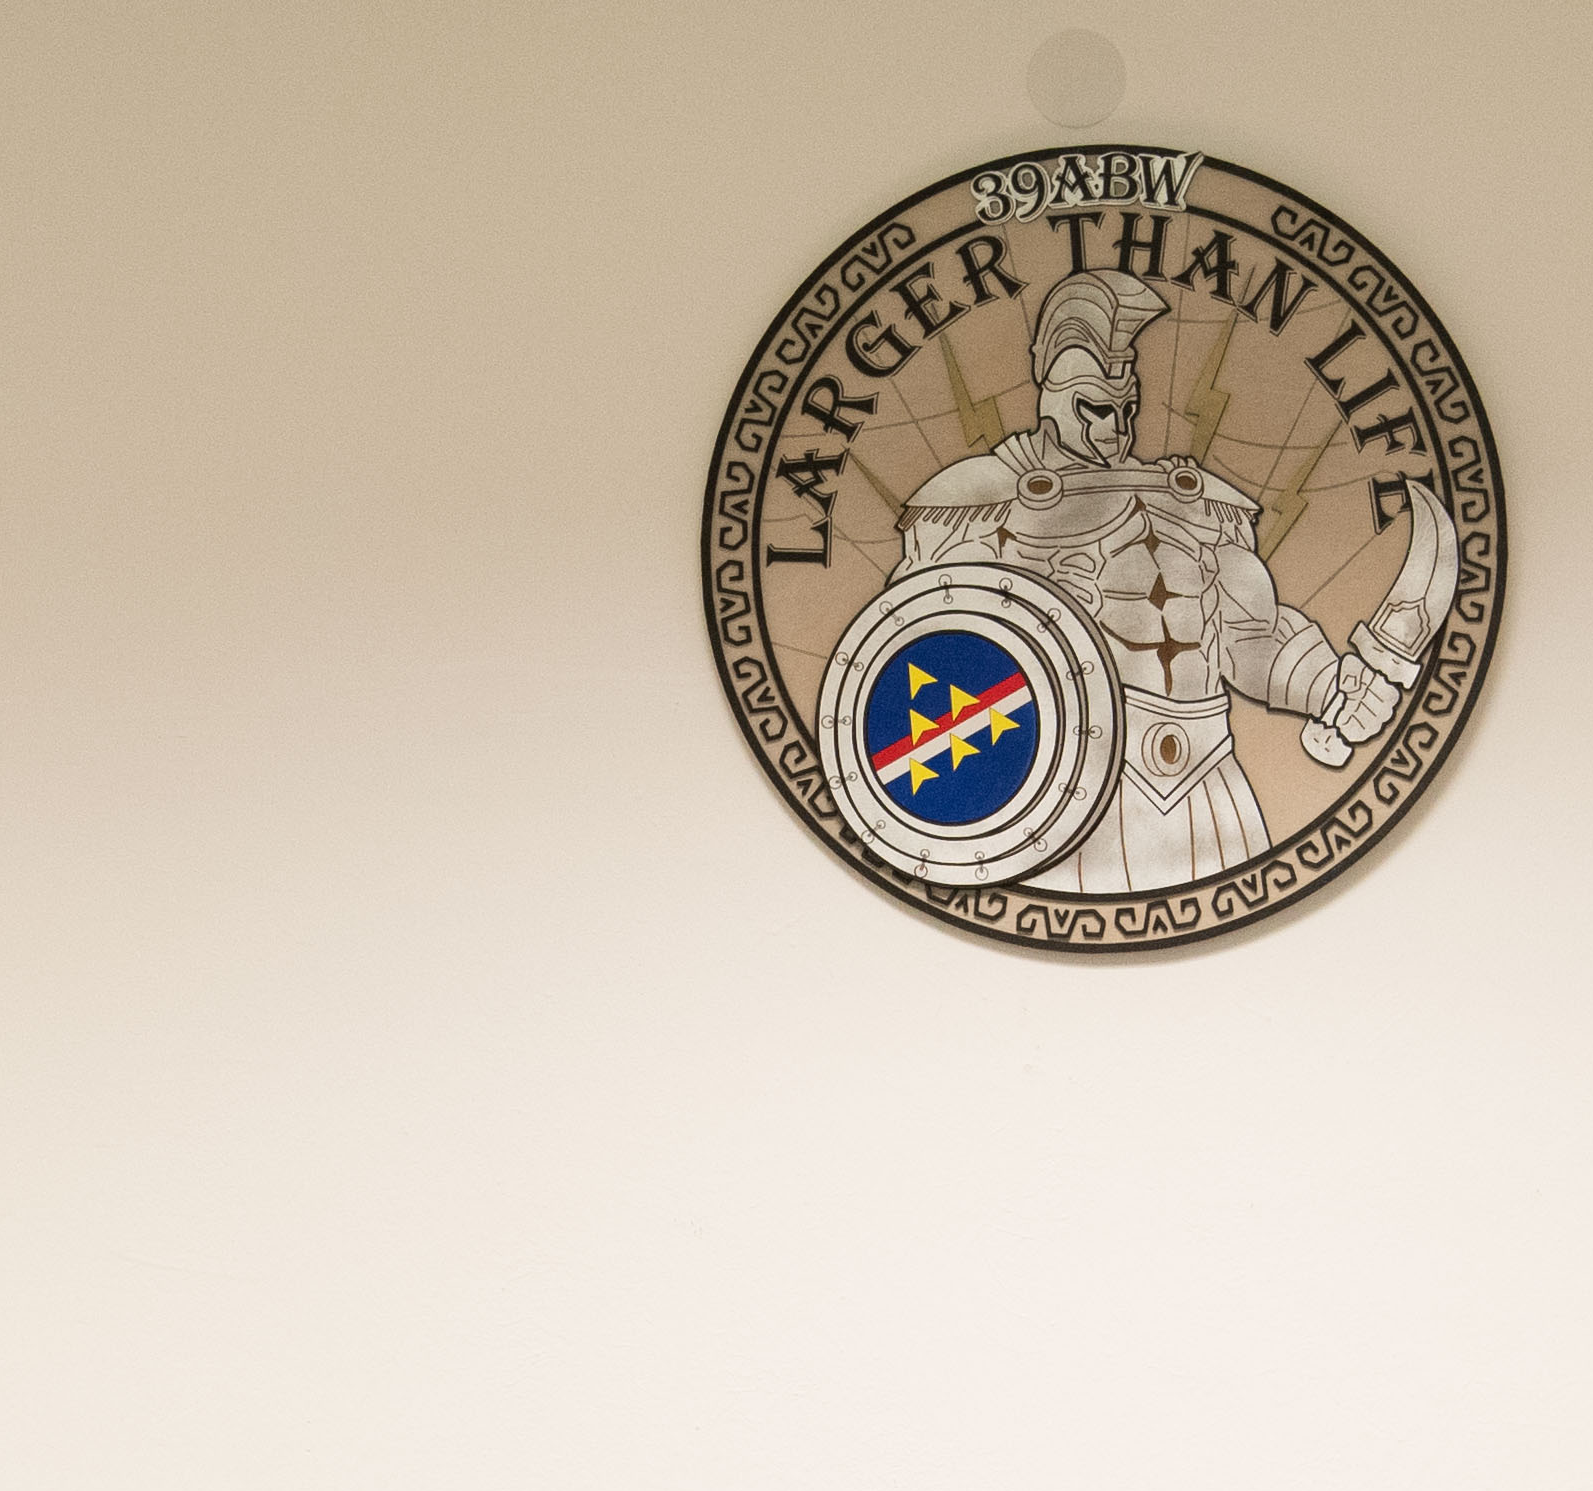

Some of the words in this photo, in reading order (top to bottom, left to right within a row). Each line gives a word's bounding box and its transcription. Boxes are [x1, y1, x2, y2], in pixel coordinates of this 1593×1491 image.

[971, 151, 1205, 225] 39ABW
[767, 234, 1028, 567] LARGER
[1048, 211, 1318, 337] THAN
[1304, 318, 1434, 535] LIFE
